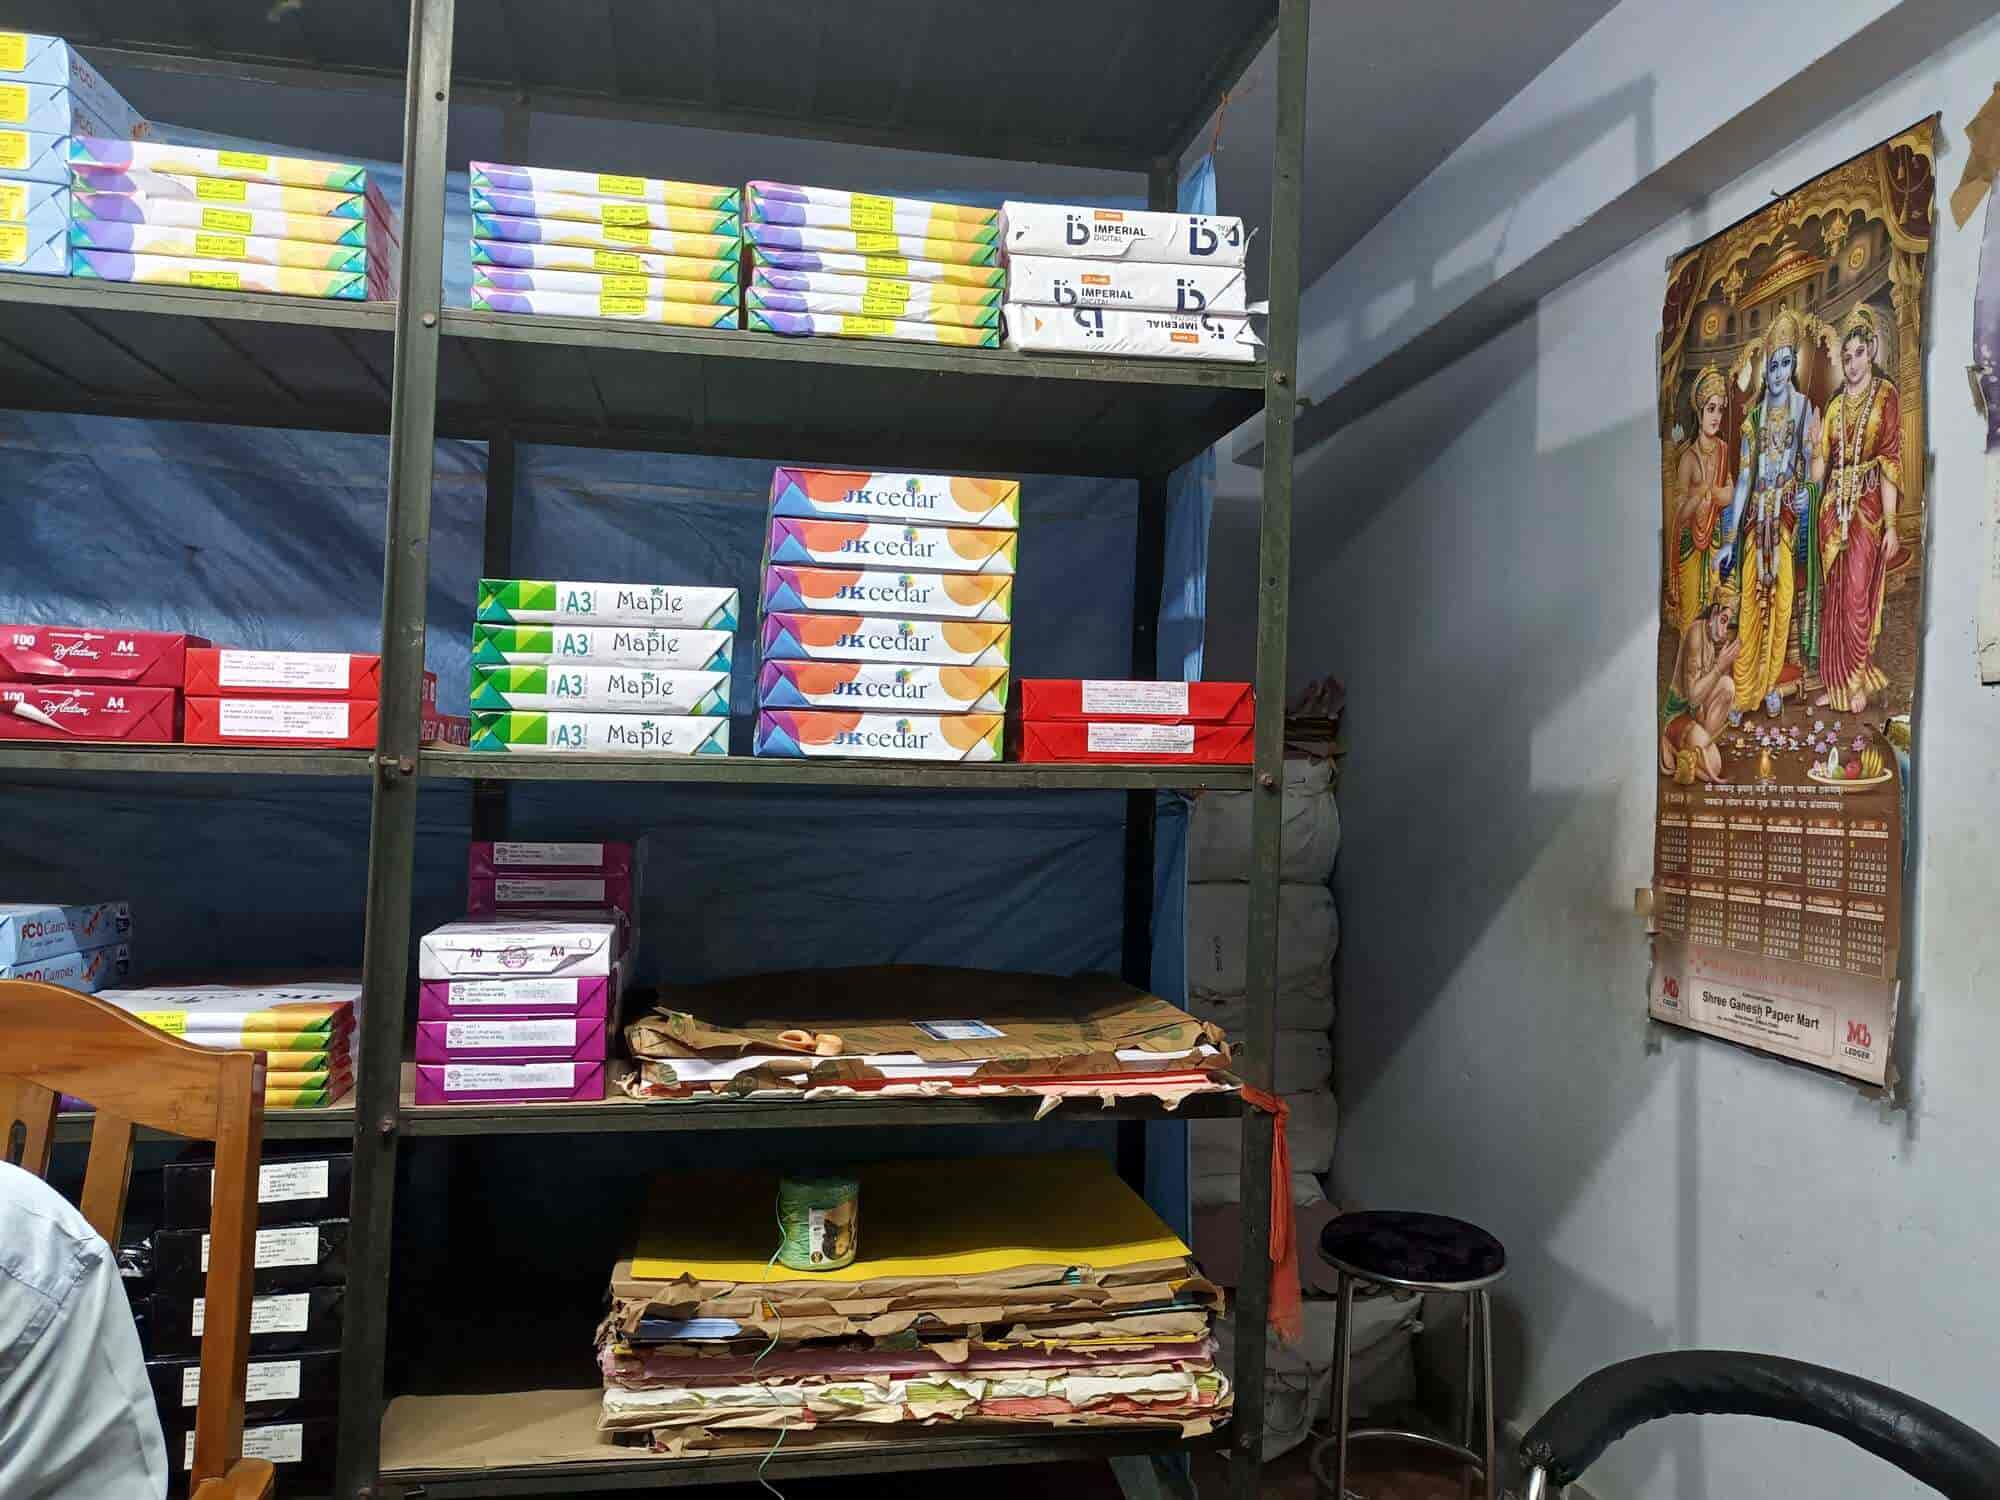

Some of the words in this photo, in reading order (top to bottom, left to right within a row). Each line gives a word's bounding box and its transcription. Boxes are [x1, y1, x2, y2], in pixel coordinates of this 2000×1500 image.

[1094, 224, 1146, 237] IMPERIAL
[1082, 288, 1133, 299] IMPERIAL
[1147, 320, 1198, 331] IMPERIAL
[566, 591, 592, 613] A3
[617, 591, 683, 615] Maple
[12, 634, 35, 647] 100
[117, 640, 135, 653] A4
[563, 633, 588, 656] A3
[612, 632, 679, 656] Maple
[557, 674, 582, 697] A3
[607, 674, 674, 699] Maple
[107, 696, 125, 709] A4
[556, 724, 583, 746] A3
[607, 725, 673, 749] Maple
[550, 946, 565, 957] A4
[1702, 991, 1727, 1007] Shree
[1729, 998, 1763, 1016] Ganesh
[1766, 1006, 1795, 1024] Paper
[1797, 1013, 1820, 1030] Mart
